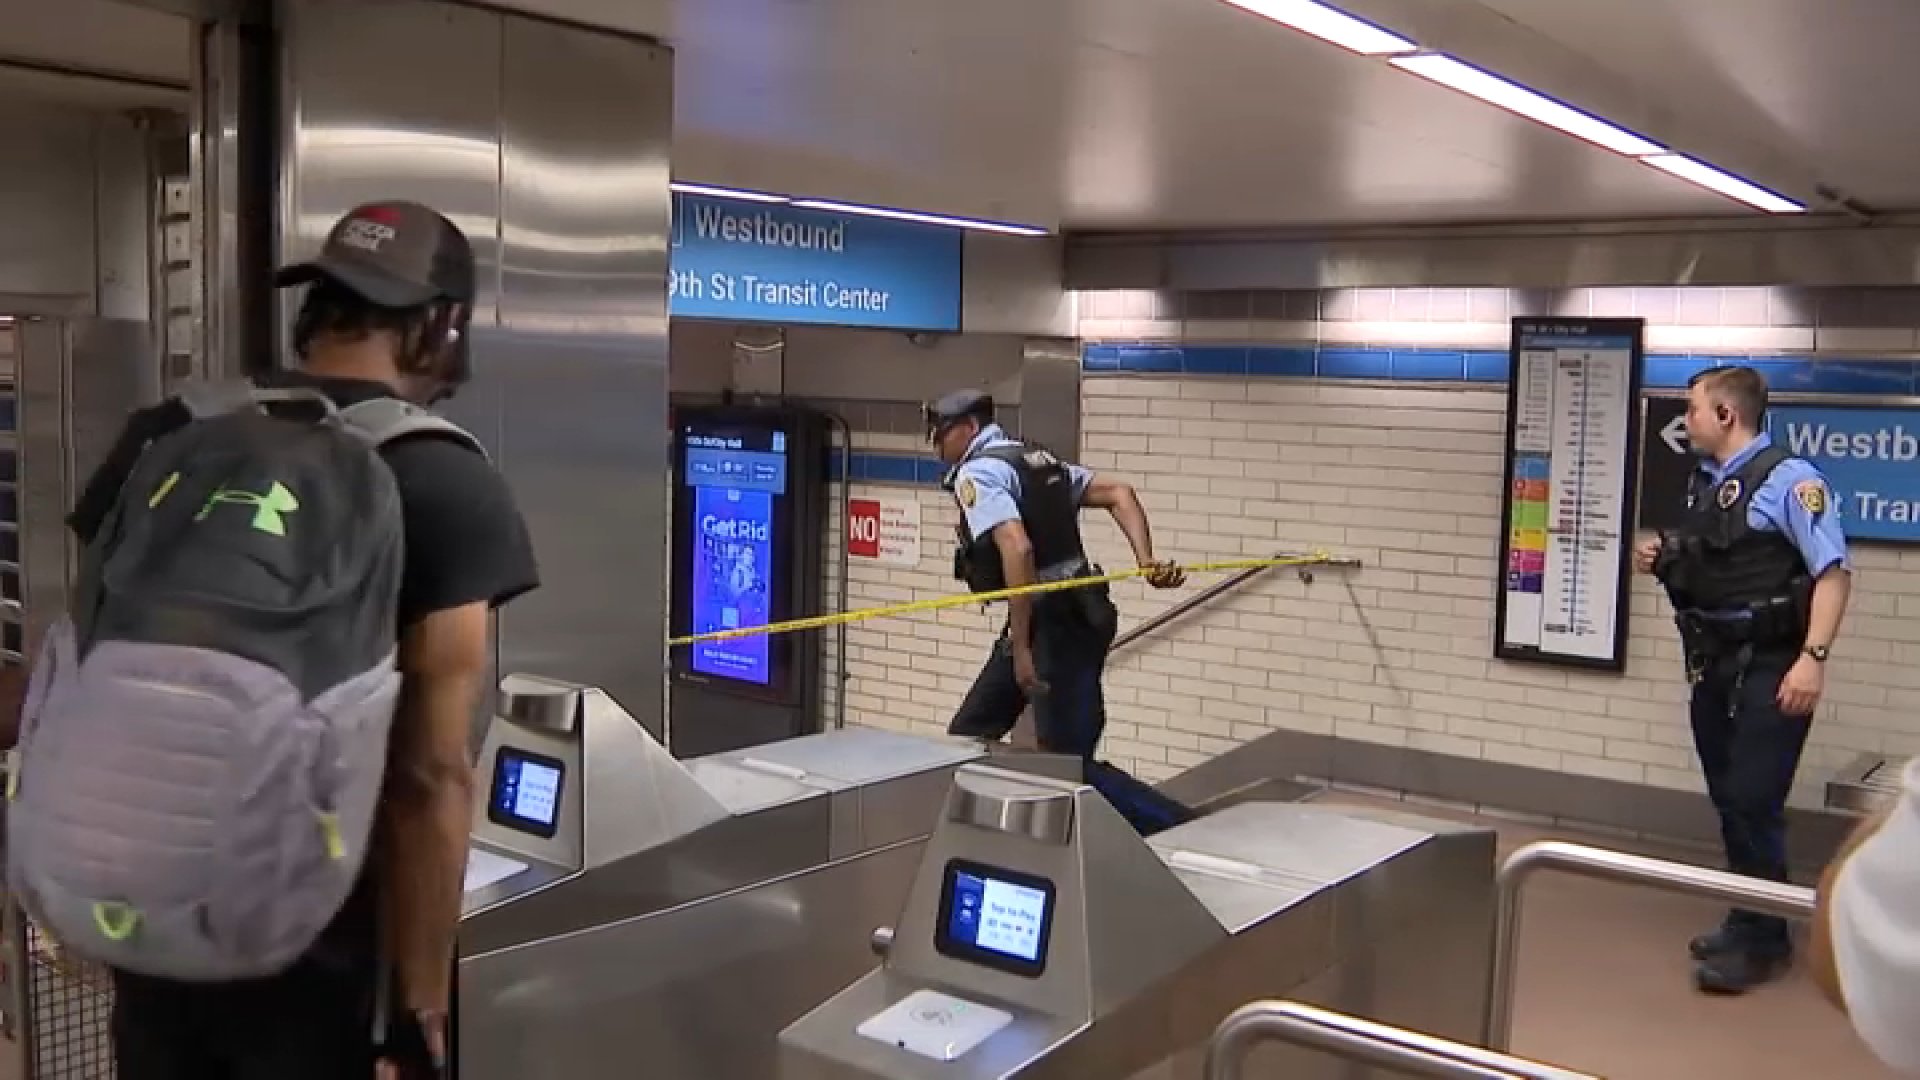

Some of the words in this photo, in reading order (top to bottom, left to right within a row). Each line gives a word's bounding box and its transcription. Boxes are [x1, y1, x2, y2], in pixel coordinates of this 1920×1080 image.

[695, 205, 844, 252] Westbound
[711, 272, 735, 301] St
[742, 275, 817, 306] Transit
[823, 281, 889, 312] Center
[1786, 423, 1919, 461] Westb
[703, 515, 737, 538] Get
[739, 520, 766, 541] Rid
[850, 515, 876, 542] NO
